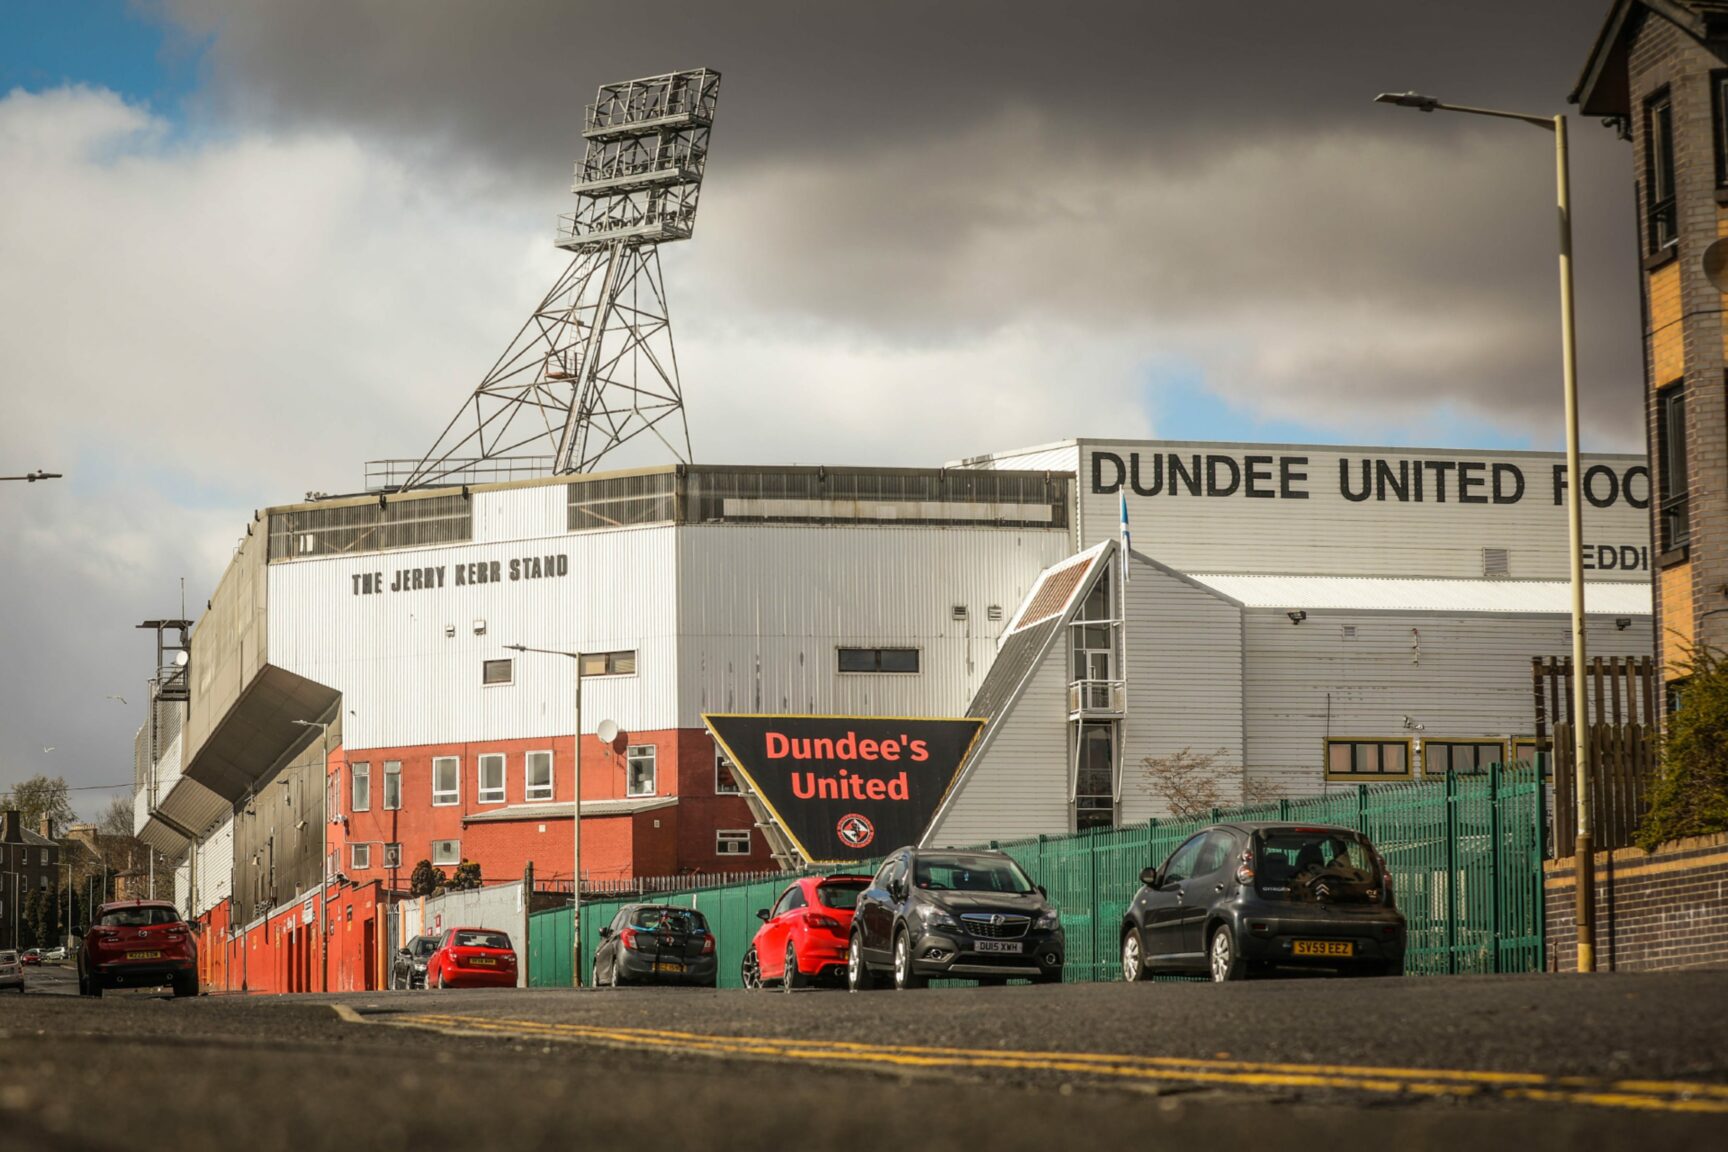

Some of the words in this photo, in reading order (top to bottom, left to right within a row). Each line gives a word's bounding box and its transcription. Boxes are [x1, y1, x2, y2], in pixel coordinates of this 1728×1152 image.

[1091, 451, 1309, 499] DUNDEE
[1339, 458, 1525, 503] UNITED
[352, 572, 382, 595] THE
[391, 566, 445, 592] JERRY
[455, 561, 501, 586] KERR
[509, 554, 568, 581] STAND
[765, 731, 929, 761] Dundee's
[791, 769, 909, 800] United
[980, 942, 999, 951] DU15
[1000, 943, 1018, 951] XWH
[1298, 942, 1326, 953] SV59
[1328, 943, 1349, 954] EEZ
